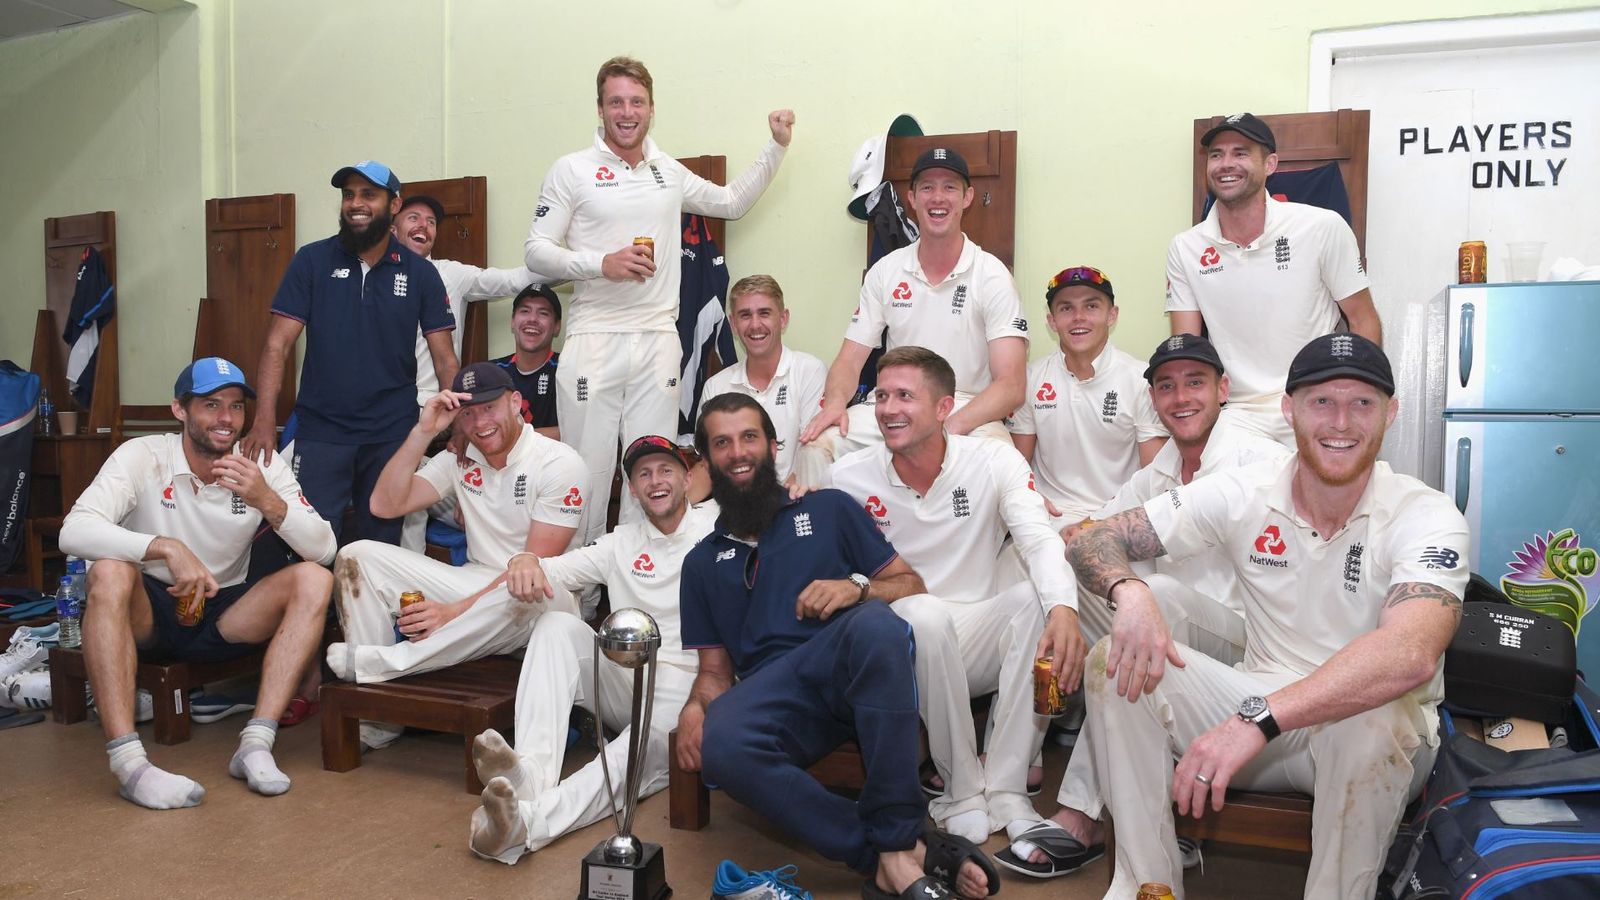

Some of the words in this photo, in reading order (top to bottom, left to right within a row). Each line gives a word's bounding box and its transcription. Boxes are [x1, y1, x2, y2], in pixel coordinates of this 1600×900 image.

[1399, 121, 1572, 155] PLAYERS
[1472, 158, 1567, 188] ONLY
[1199, 265, 1224, 275] NatWest
[6, 471, 26, 520] balance
[560, 506, 582, 515] NatWest
[1546, 528, 1597, 580] Eco
[1249, 554, 1288, 568] NatWest
[631, 569, 656, 579] NatWest
[1343, 582, 1357, 593] 658
[1504, 614, 1535, 625] CURRAN
